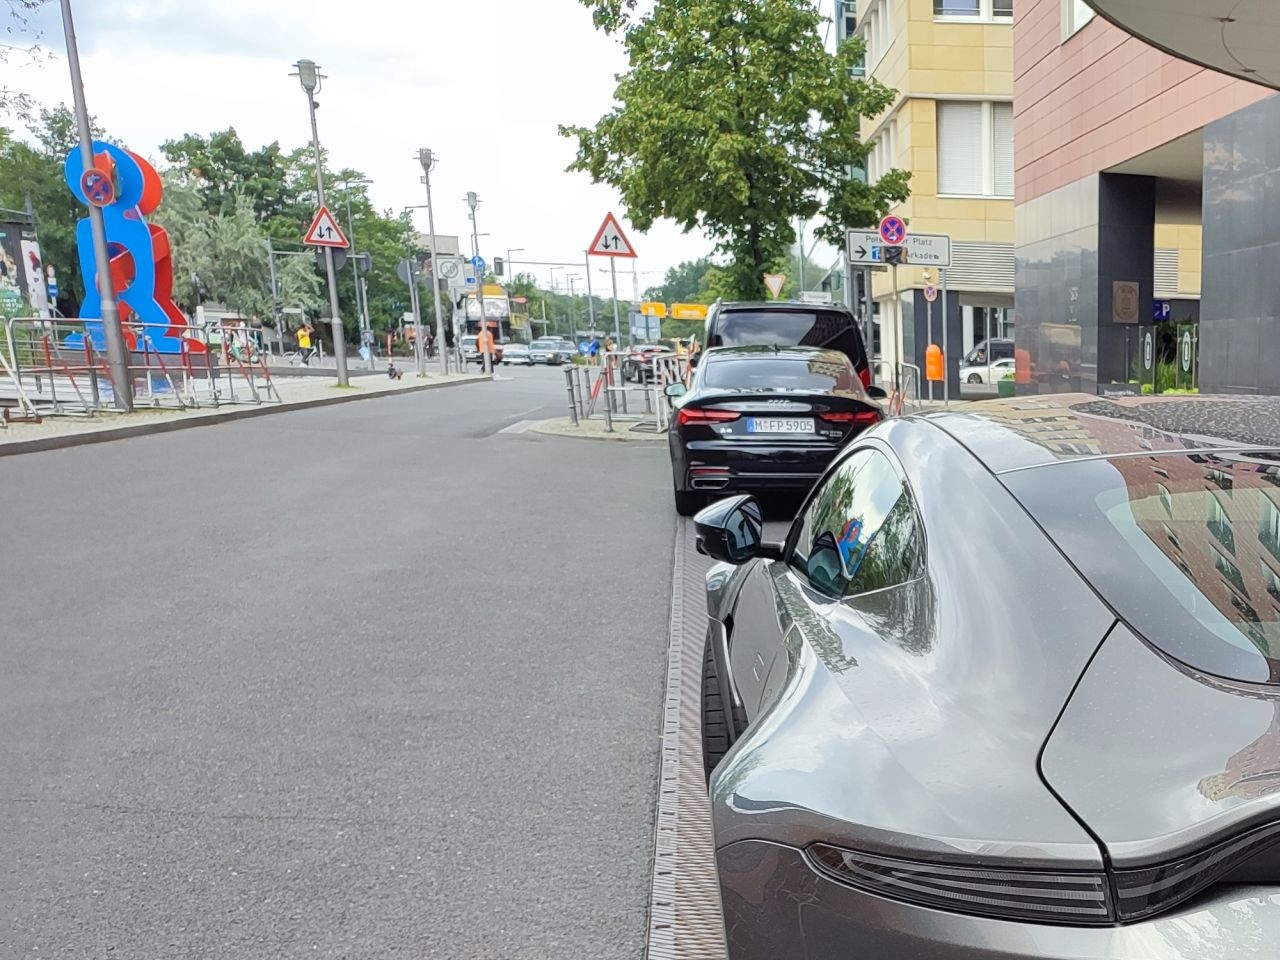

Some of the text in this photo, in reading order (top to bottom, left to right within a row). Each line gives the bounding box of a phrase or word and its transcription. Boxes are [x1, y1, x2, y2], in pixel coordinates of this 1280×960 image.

[912, 237, 933, 247] Platz
[1162, 303, 1170, 317] P
[755, 420, 813, 432] M FP 5905
